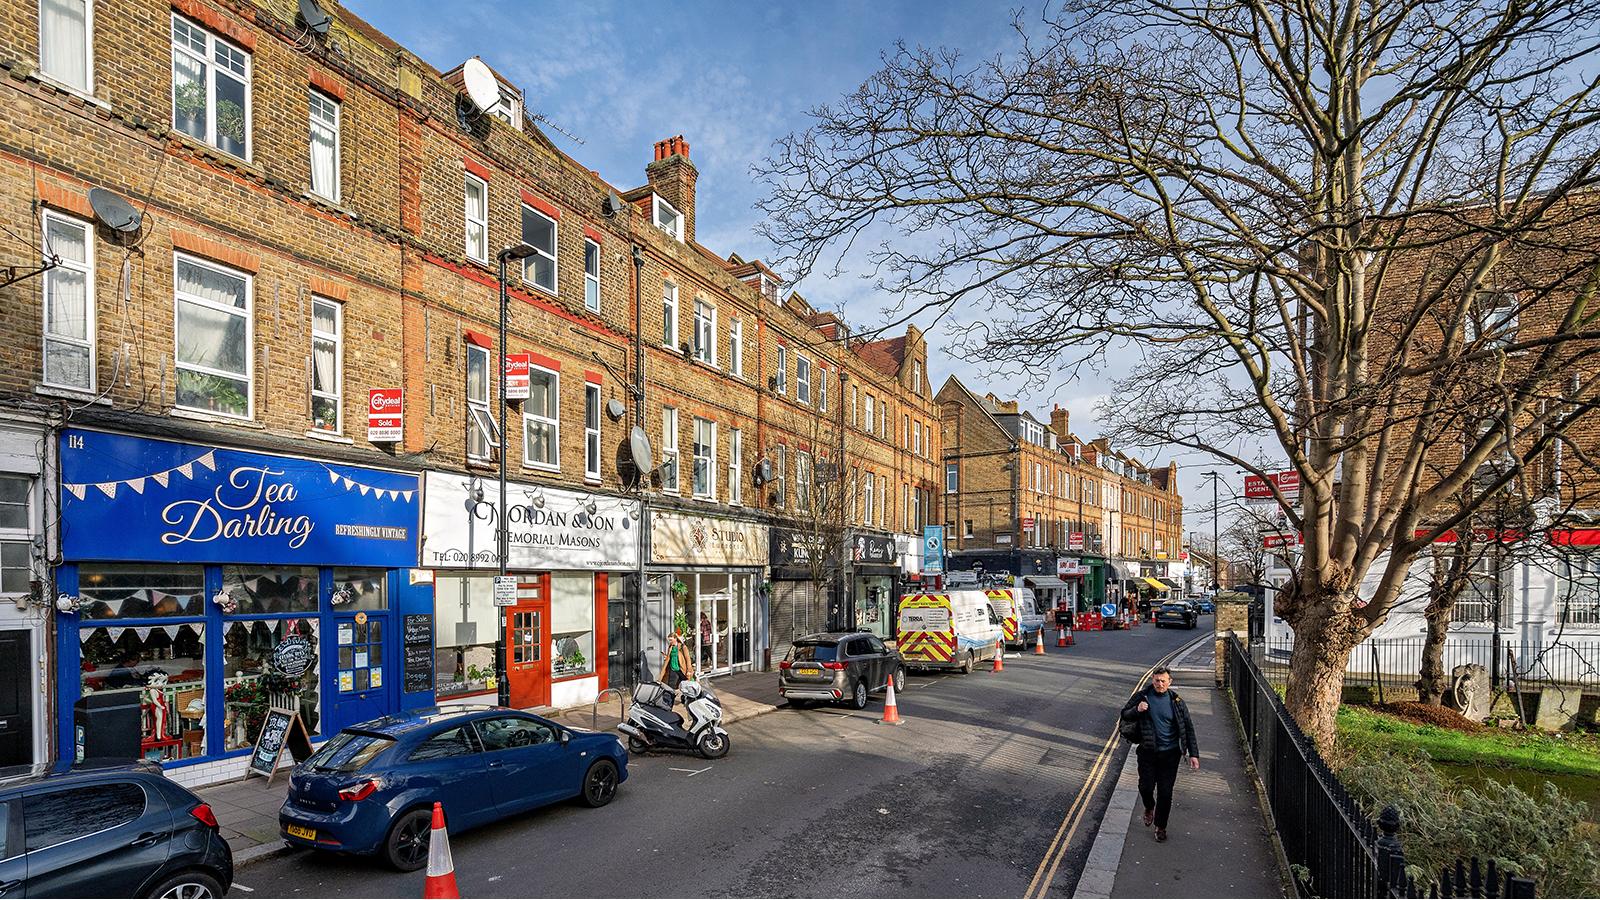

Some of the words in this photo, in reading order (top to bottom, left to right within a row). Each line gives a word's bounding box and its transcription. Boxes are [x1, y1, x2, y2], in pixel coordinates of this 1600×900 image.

[69, 435, 84, 449] 114
[215, 465, 299, 510] Tea
[161, 498, 314, 549] Darling
[501, 504, 566, 527] ORDAN
[571, 513, 583, 528] &
[586, 513, 615, 531] SON
[335, 524, 381, 537] REFRESHINGLY
[382, 527, 407, 540] VINTAGE
[712, 528, 744, 542] STUDIO
[558, 533, 600, 548] MASONS
[433, 551, 451, 561] TEL:
[453, 552, 468, 562] 020
